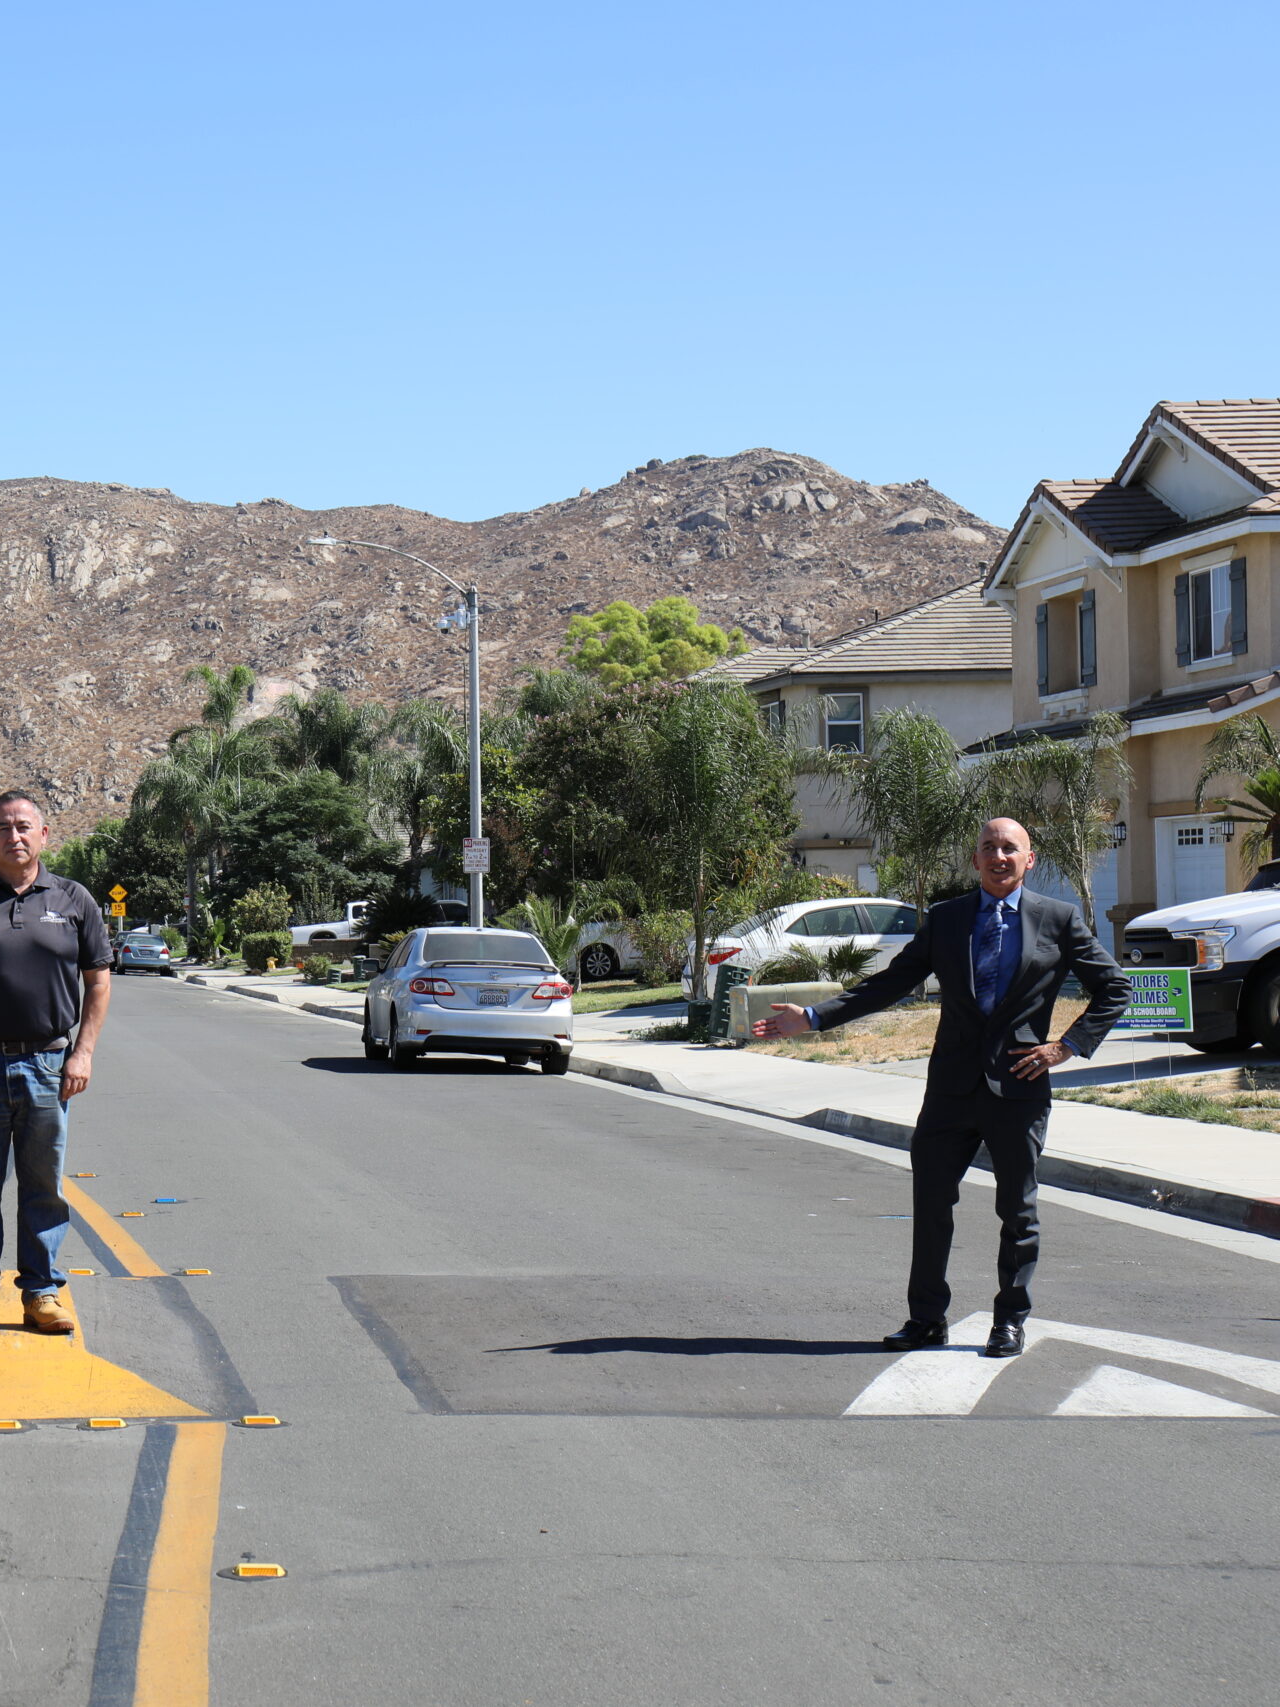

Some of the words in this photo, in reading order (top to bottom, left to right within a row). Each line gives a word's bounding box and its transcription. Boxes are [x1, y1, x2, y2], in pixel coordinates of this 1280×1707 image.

[1130, 975, 1169, 988] OLORES
[1132, 991, 1168, 1003] OLMES
[1133, 1007, 1177, 1016] SCHOOLBOARD
